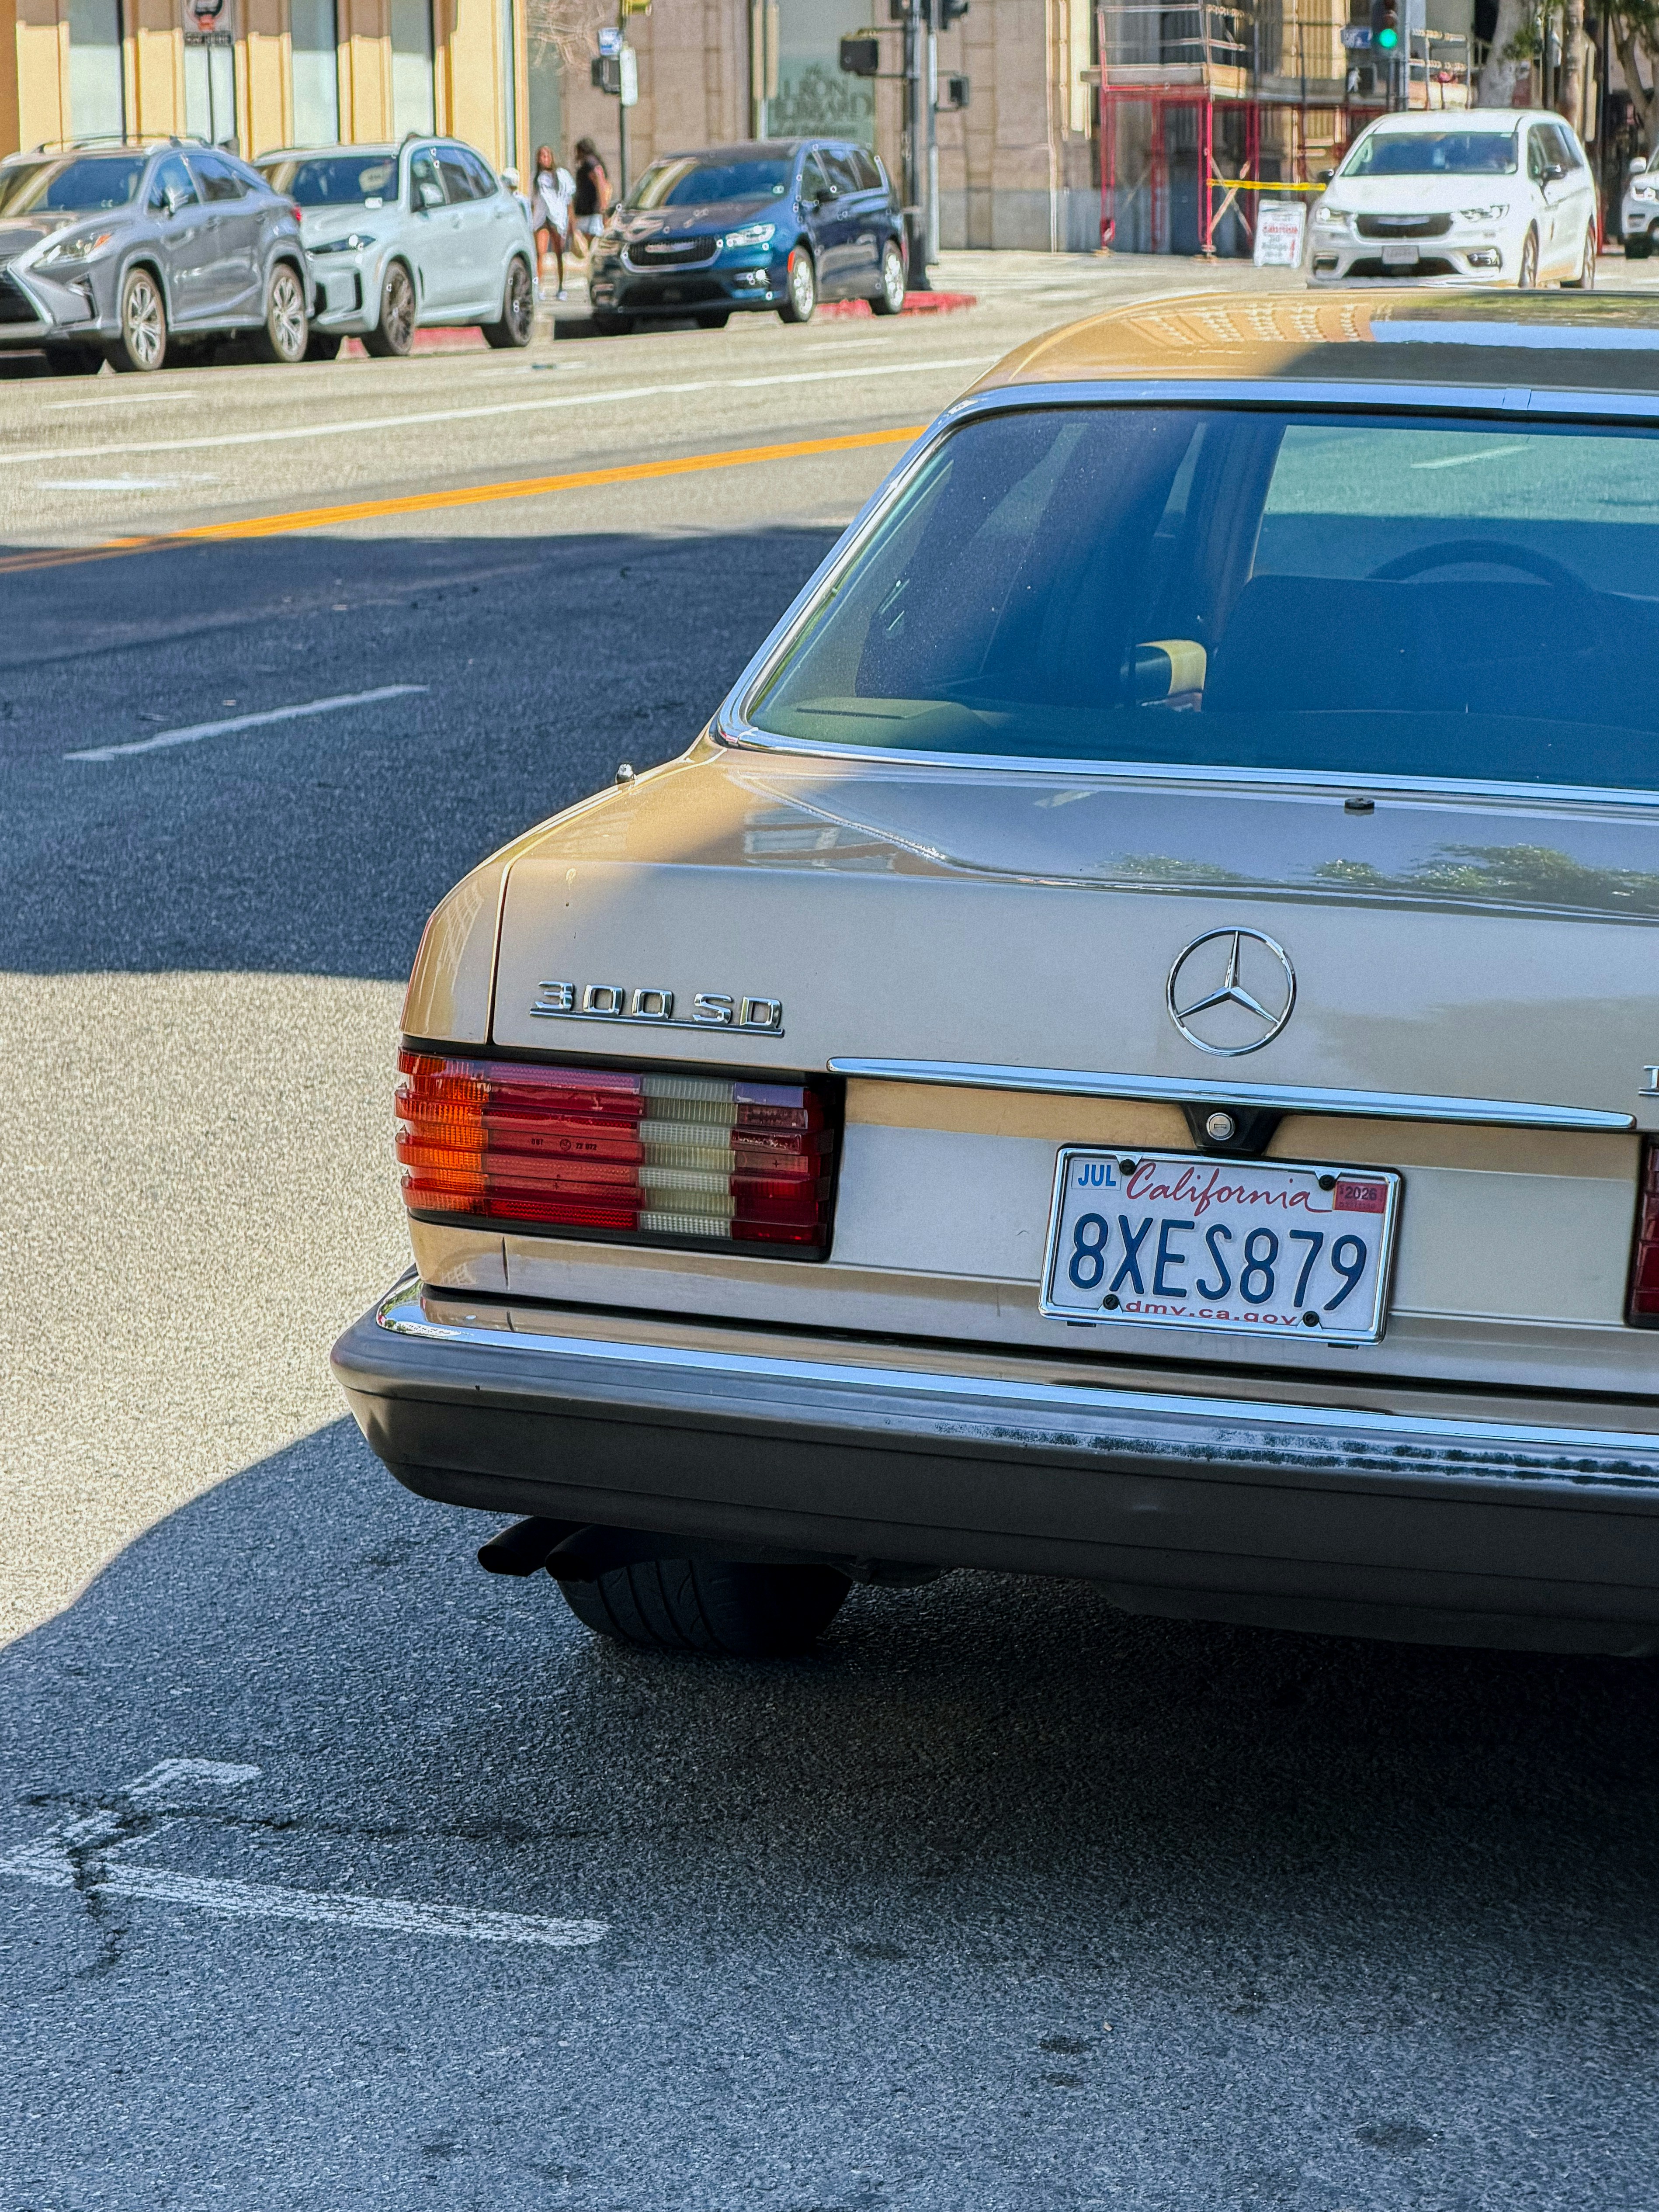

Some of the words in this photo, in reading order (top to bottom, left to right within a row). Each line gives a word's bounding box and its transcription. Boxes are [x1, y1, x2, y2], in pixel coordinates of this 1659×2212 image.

[535, 981, 673, 1019] 300
[692, 993, 782, 1028] SD
[1078, 1164, 1116, 1186] JUL
[1126, 1162, 1333, 1217] California
[1344, 1186, 1377, 1201] 2026
[1069, 1213, 1367, 1311] 8XES879
[1126, 1300, 1298, 1325] dmv.ca.gov
